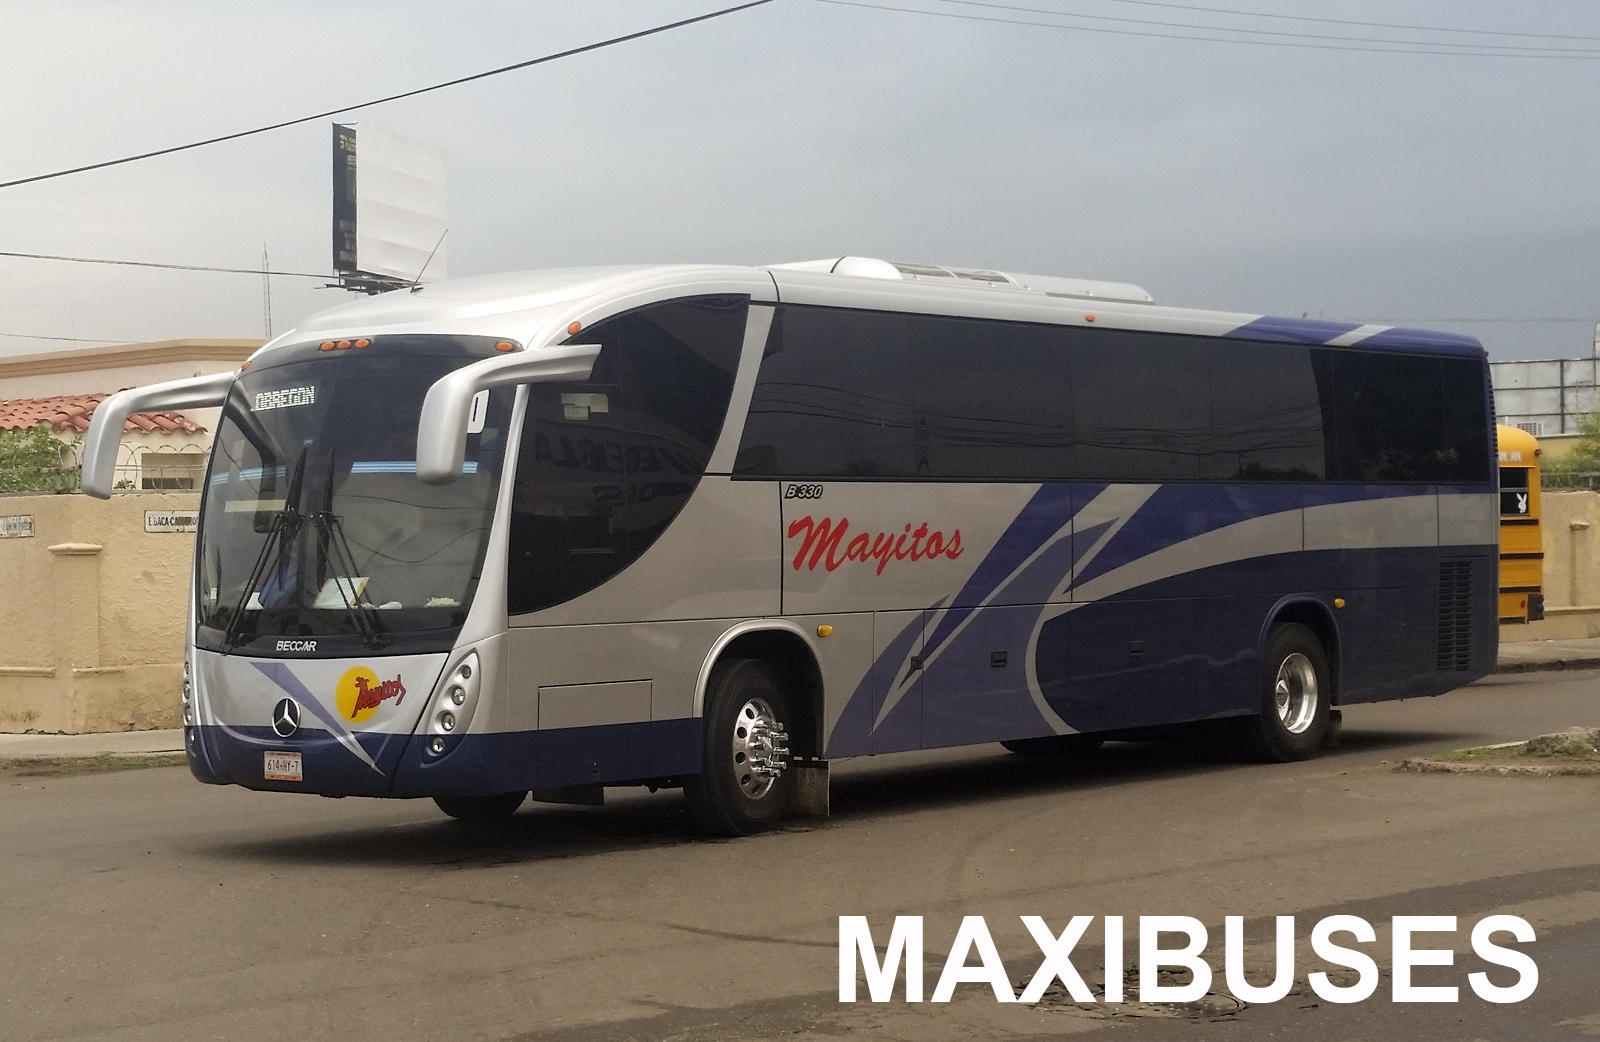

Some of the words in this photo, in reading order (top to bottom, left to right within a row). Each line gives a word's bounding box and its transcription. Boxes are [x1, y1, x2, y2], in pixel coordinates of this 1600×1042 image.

[785, 484, 799, 499] B
[798, 484, 824, 499] 330
[788, 515, 965, 576] Mayitos
[275, 640, 318, 652] BECCAR
